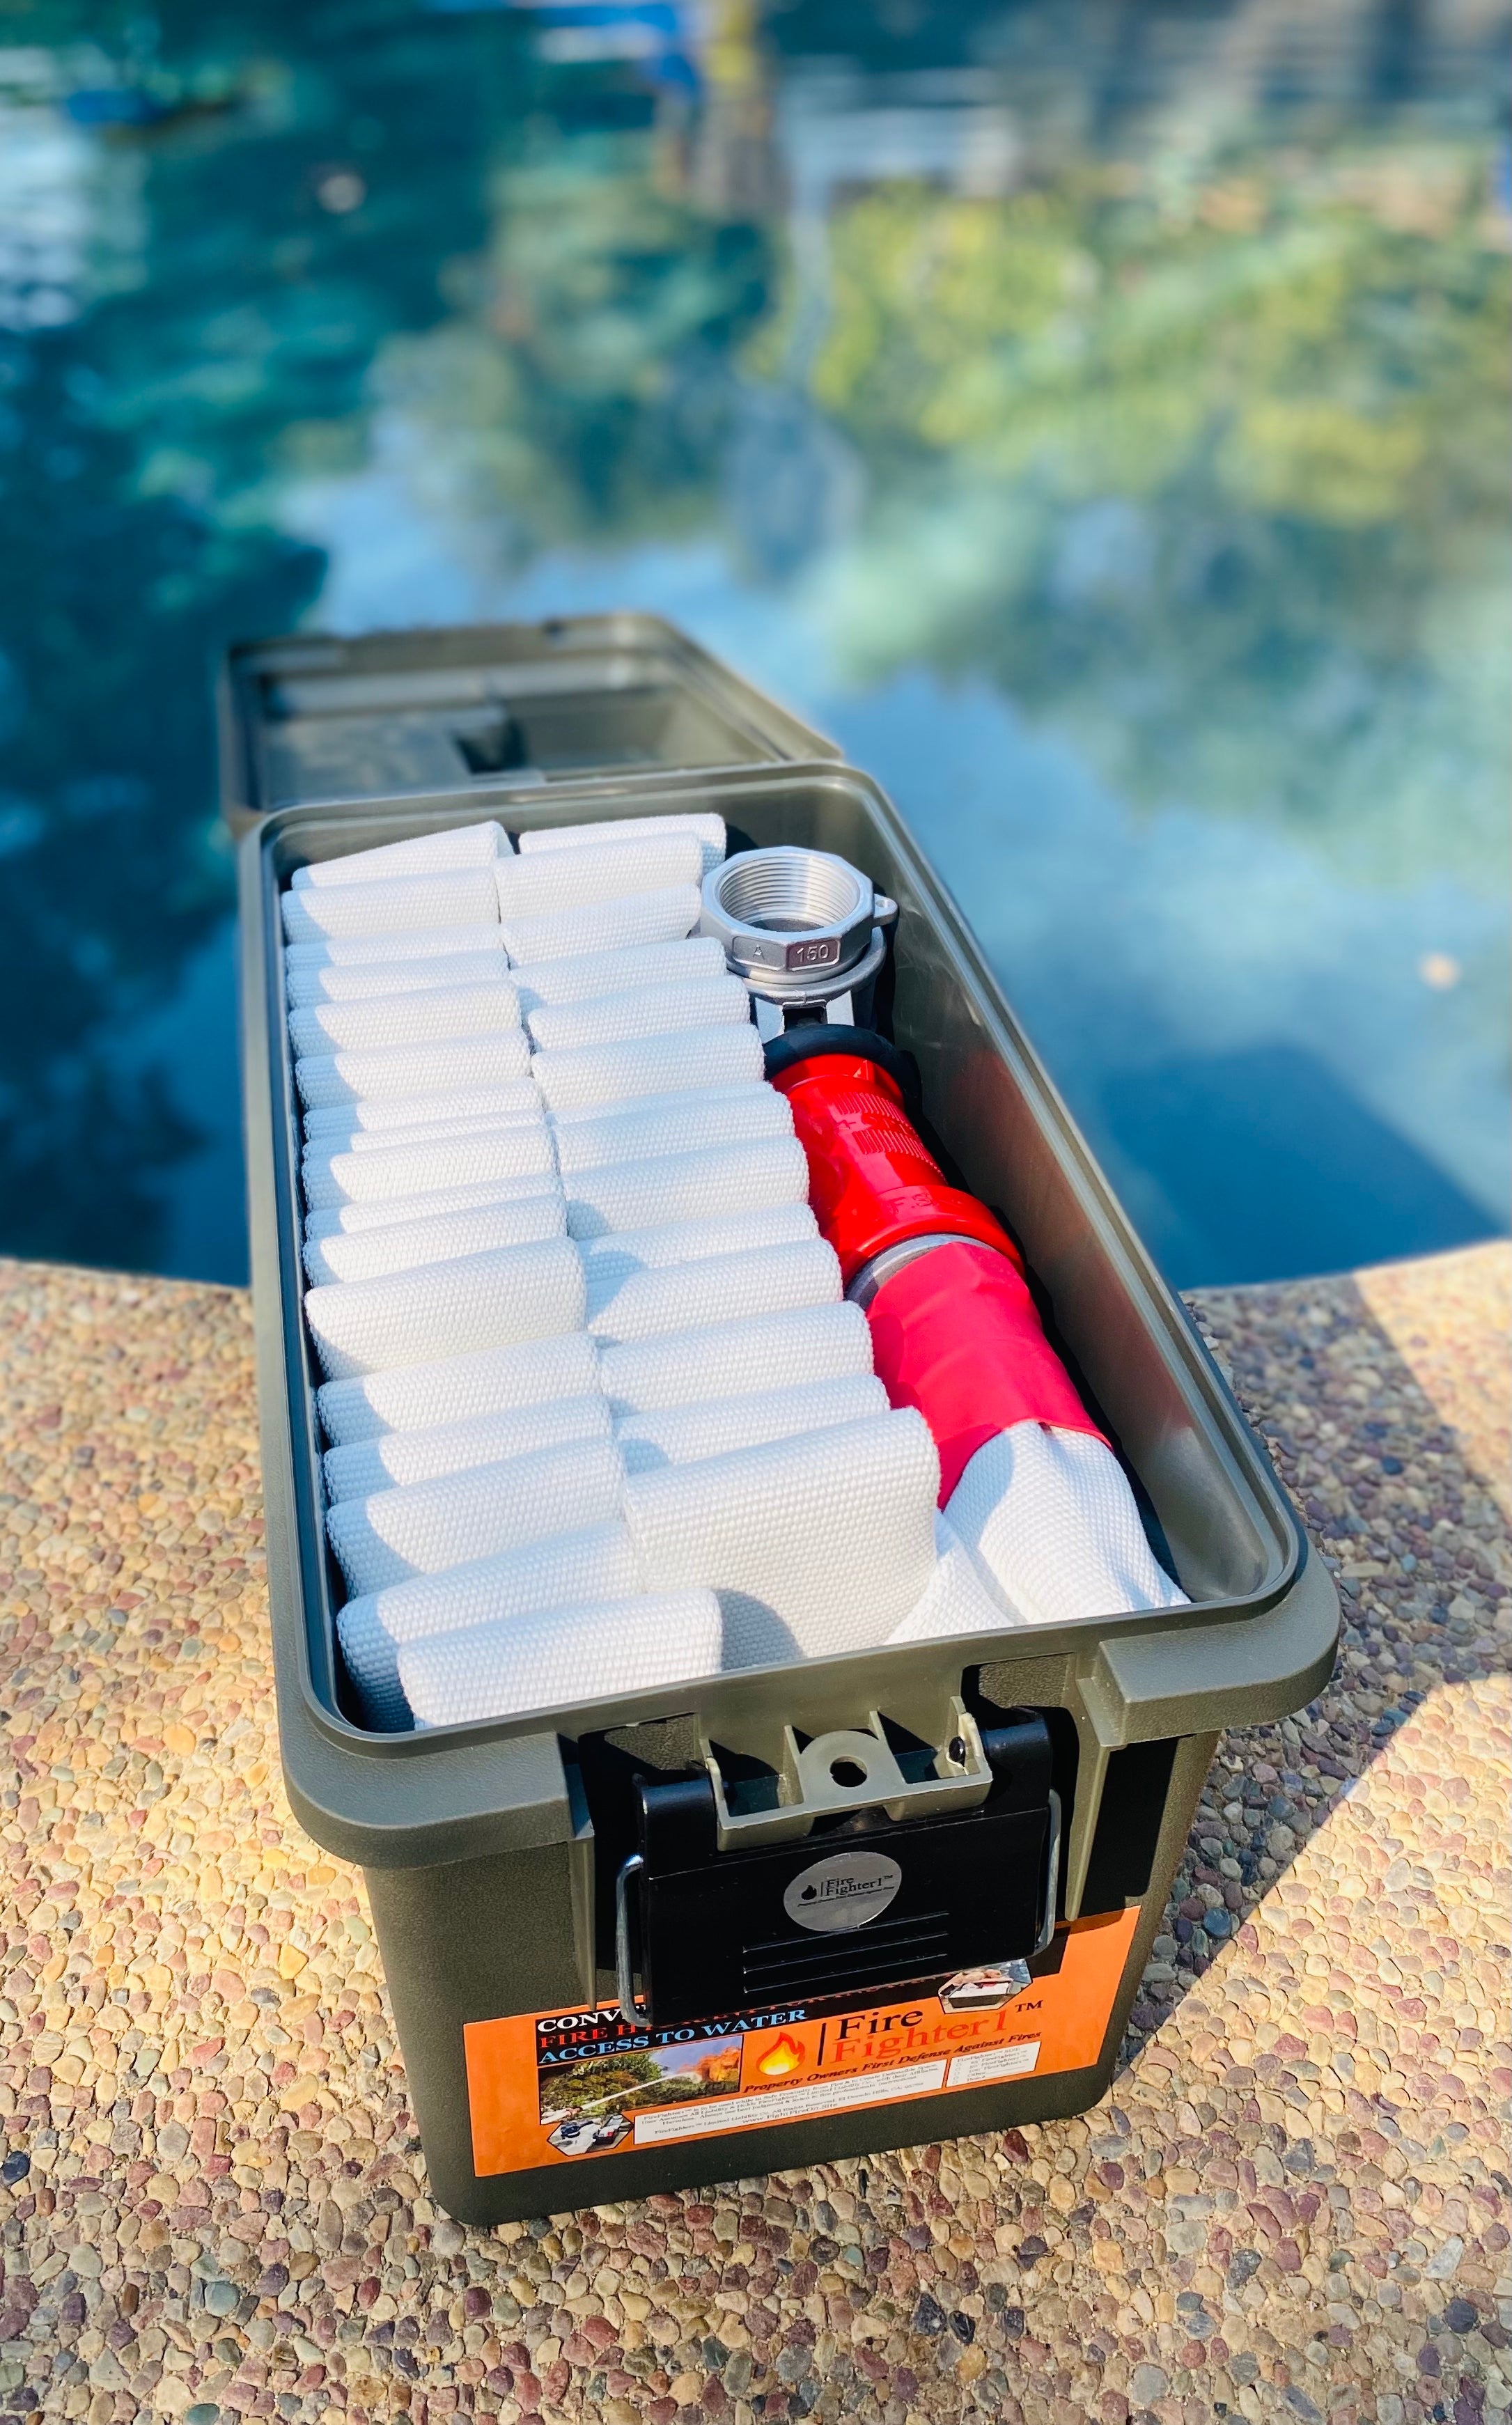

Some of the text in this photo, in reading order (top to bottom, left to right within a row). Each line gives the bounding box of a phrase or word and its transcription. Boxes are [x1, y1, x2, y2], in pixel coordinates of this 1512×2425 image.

[796, 944, 829, 962] 150
[826, 1877, 855, 1889] Fire
[538, 2035, 648, 2064] ACCESS
[655, 2029, 695, 2044] TO
[701, 2009, 809, 2036] WATER
[540, 2027, 608, 2048] FIRE
[835, 2010, 923, 2041] Fire
[743, 2032, 1042, 2094] Property Owners First Defense Against Fires
